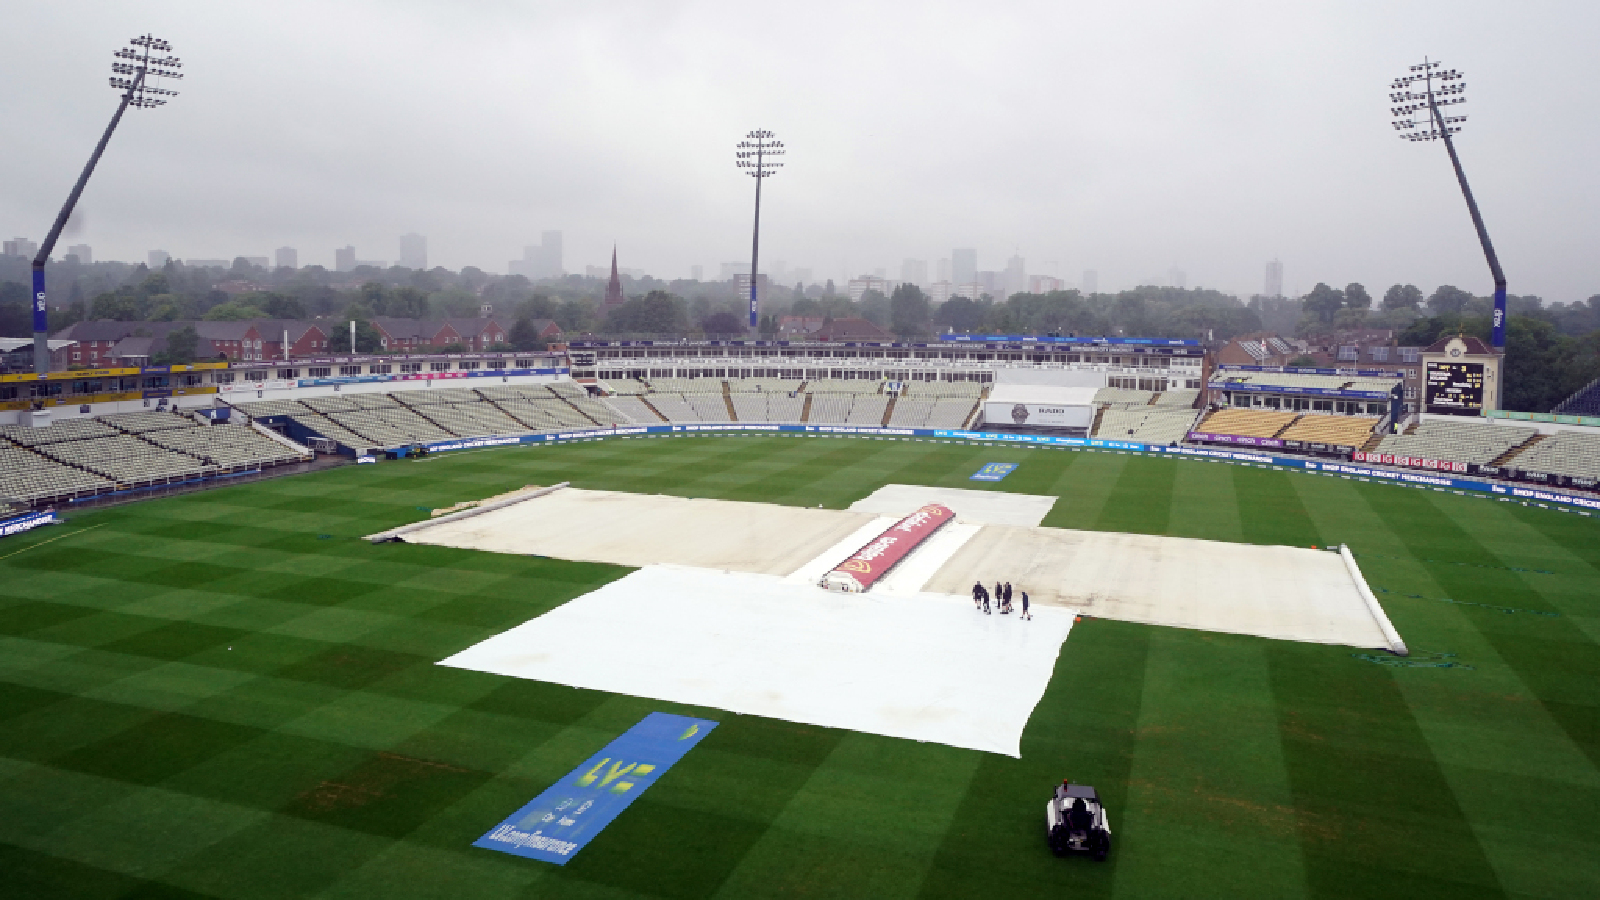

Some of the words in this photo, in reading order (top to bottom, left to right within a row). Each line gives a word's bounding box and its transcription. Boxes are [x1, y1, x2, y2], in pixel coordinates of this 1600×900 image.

[1340, 465, 1371, 475] ENGLAND
[1371, 470, 1400, 479] CRICKET
[1401, 473, 1452, 486] MERCHANDISE
[1513, 488, 1534, 497] SHOP
[1535, 491, 1572, 503] ENGLAND
[573, 757, 656, 796] LV=
